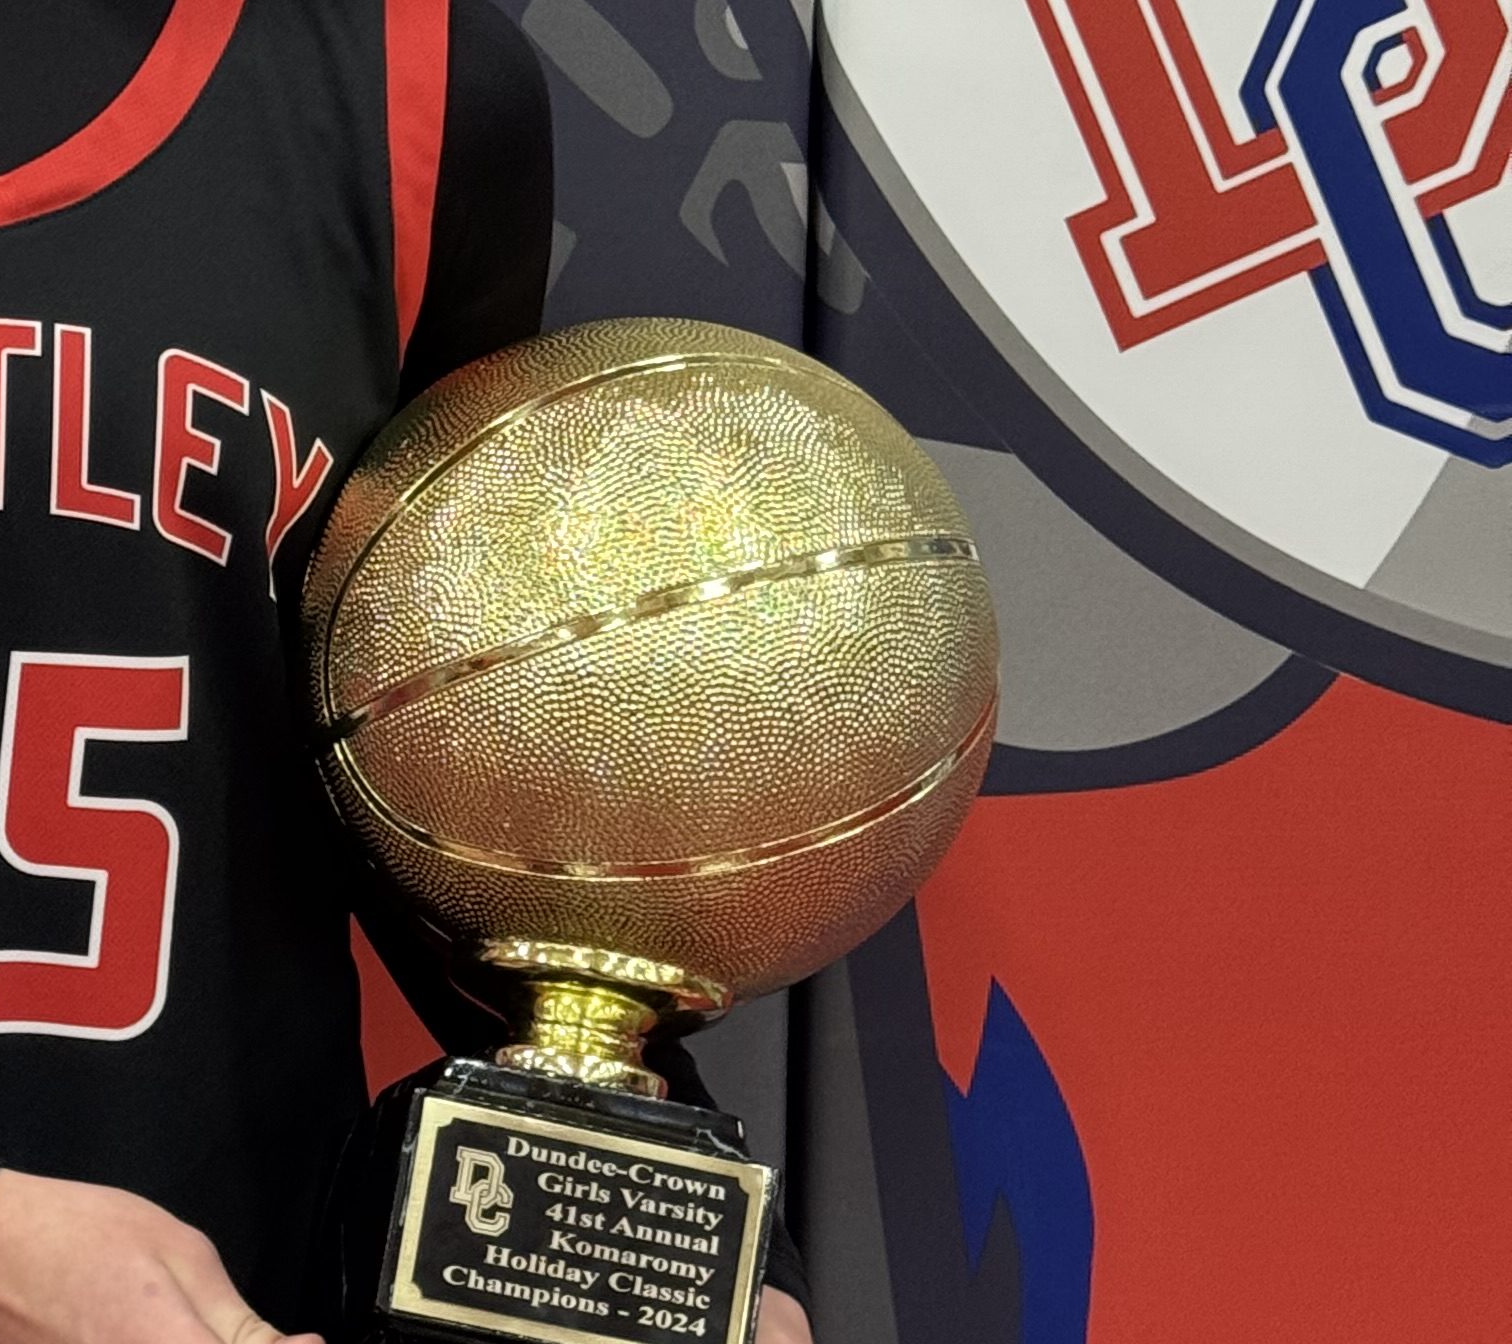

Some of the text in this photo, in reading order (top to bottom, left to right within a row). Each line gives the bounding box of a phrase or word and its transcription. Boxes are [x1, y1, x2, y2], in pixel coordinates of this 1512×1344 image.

[449, 1145, 514, 1237] DC
[506, 1136, 726, 1201] Dundee-Crown
[538, 1172, 724, 1231] Girls Varsity
[545, 1203, 720, 1256] 41st Annual
[483, 1244, 711, 1310] Holiday Classic
[549, 1229, 715, 1286] Komaromy
[442, 1265, 609, 1316] Champions
[637, 1306, 707, 1337] 2024
